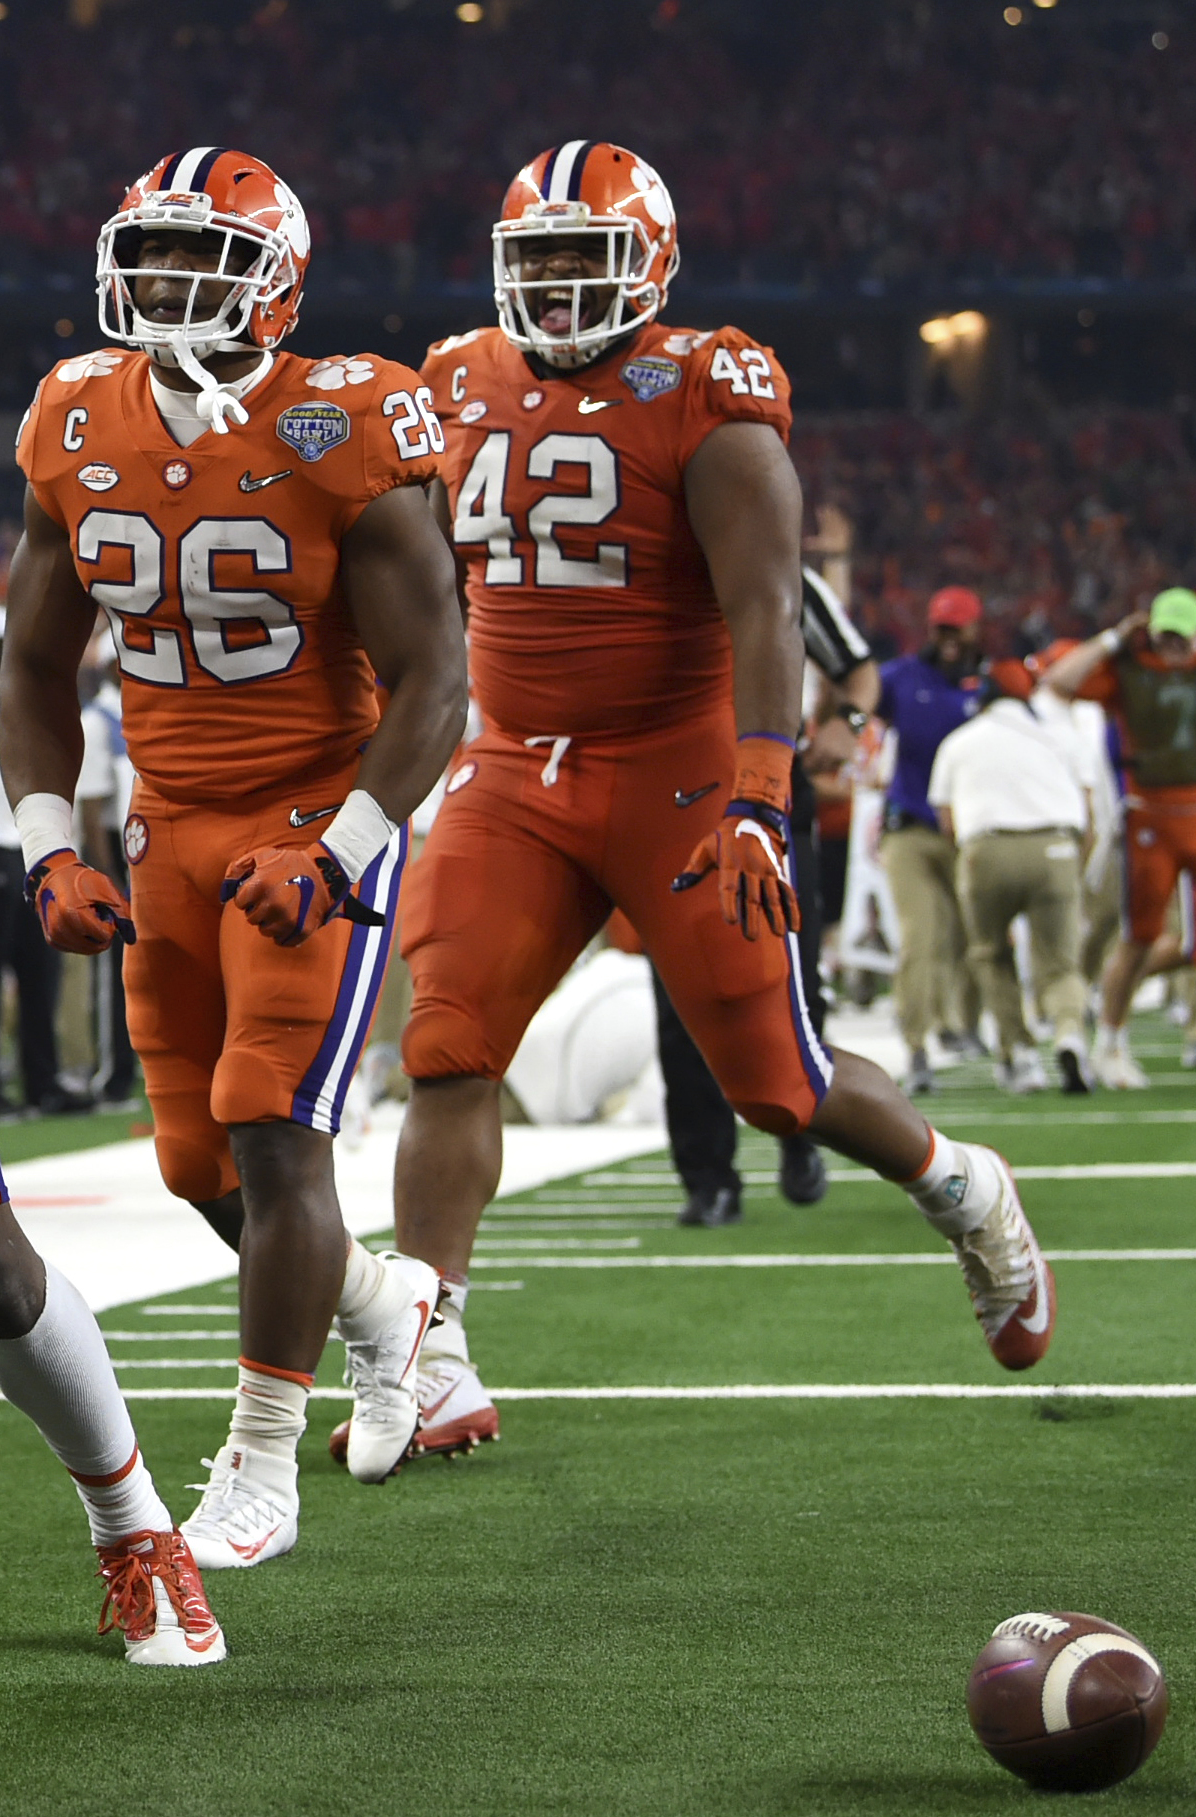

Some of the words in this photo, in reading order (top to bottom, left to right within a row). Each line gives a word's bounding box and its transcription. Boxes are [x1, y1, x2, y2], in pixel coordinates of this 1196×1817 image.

[451, 365, 468, 403] C
[709, 347, 778, 400] 42
[62, 407, 89, 452] C
[283, 418, 344, 438] COTTON
[293, 428, 332, 441] BOWL
[382, 386, 445, 461] 26
[83, 469, 115, 481] ACC
[453, 430, 631, 588] 42
[77, 506, 304, 688] 26
